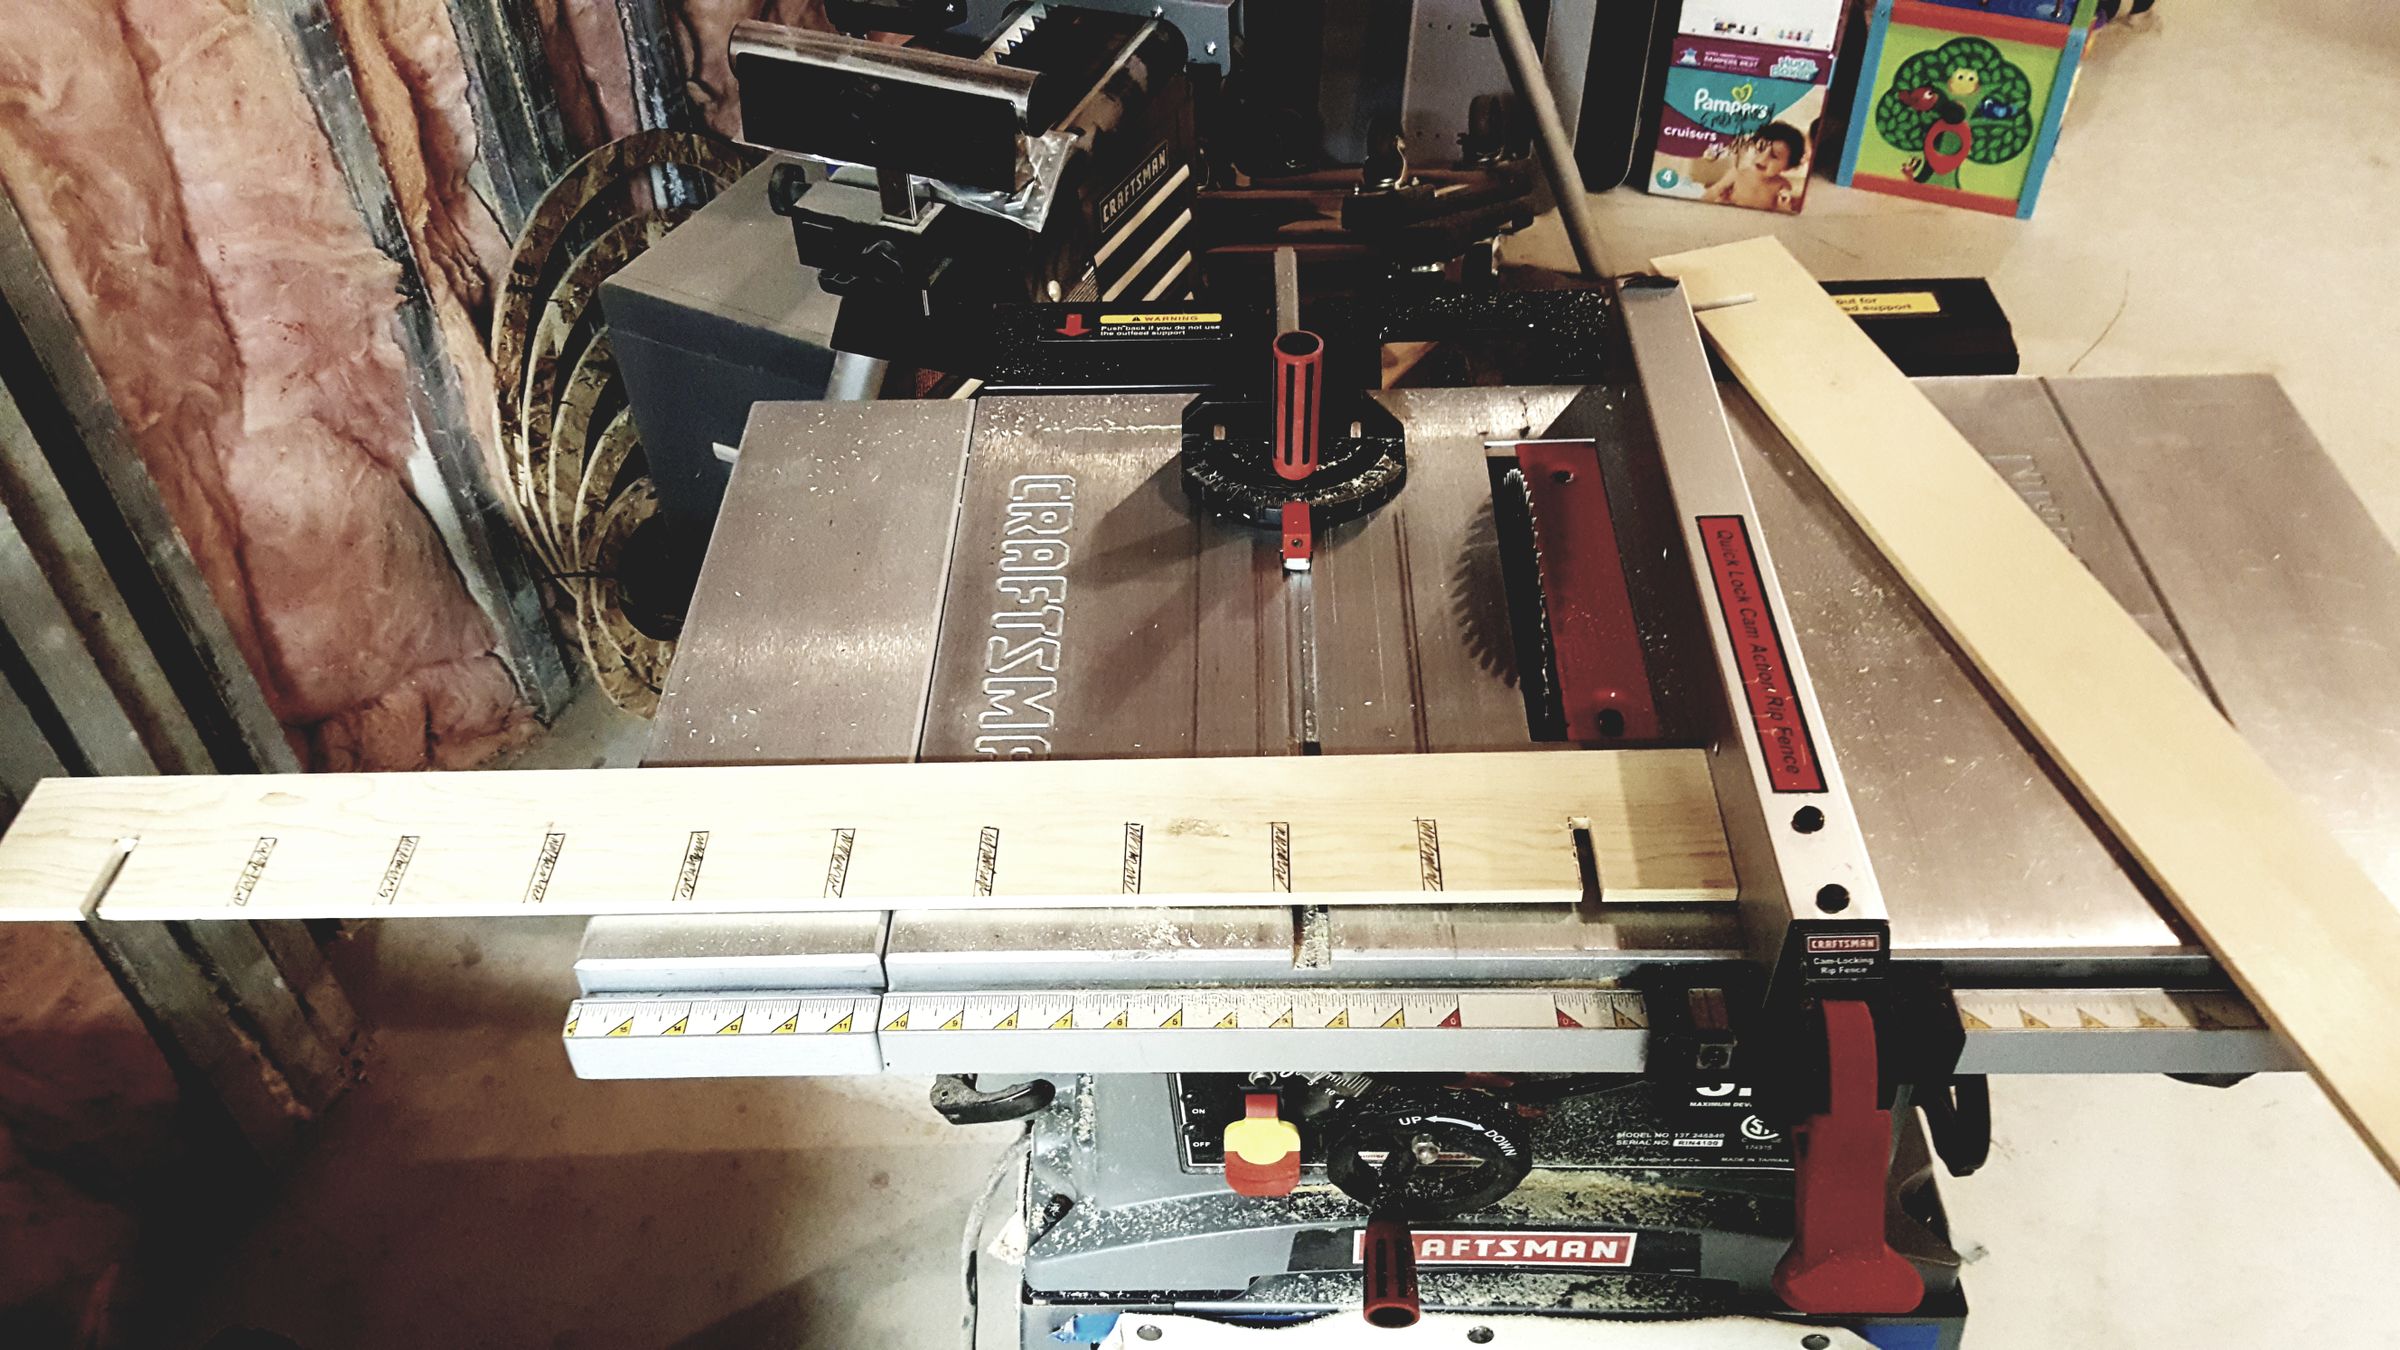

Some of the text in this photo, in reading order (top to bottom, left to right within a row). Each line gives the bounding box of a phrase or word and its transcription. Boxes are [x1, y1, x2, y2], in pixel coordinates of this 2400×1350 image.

[1694, 88, 1769, 119] Pampers
[1663, 126, 1717, 141] cruisers
[1661, 170, 1673, 183] 4
[1103, 149, 1166, 223] CRAFTSMAN
[974, 474, 1076, 759] CRAFTSMA
[1716, 528, 1801, 775] Quick Lock Cam Action Rip Fence
[1811, 938, 1875, 950] CRAFTSMAN
[1813, 956, 1875, 967] Cam-Locking
[1820, 966, 1868, 975] Rip Fence
[619, 1026, 629, 1034] 15
[673, 1025, 683, 1033] 14
[730, 1024, 739, 1032] 13
[784, 1023, 794, 1031] 12
[838, 1022, 848, 1030] 11
[895, 1020, 907, 1028] 10
[952, 1020, 959, 1028] 9
[1006, 1019, 1014, 1028] 8
[1062, 1019, 1070, 1027] 7
[1116, 1018, 1124, 1027] 6
[1171, 1018, 1179, 1027] 5
[1226, 1018, 1234, 1026] 4
[1337, 1017, 1345, 1026] 2
[1449, 1017, 1458, 1027] 0
[1562, 1018, 1570, 1026] 0
[1324, 1088, 1336, 1096] 10
[1399, 1116, 1422, 1126] UP
[1484, 1129, 1517, 1157] DOWN
[1420, 1238, 1619, 1259] AFTSMAN
